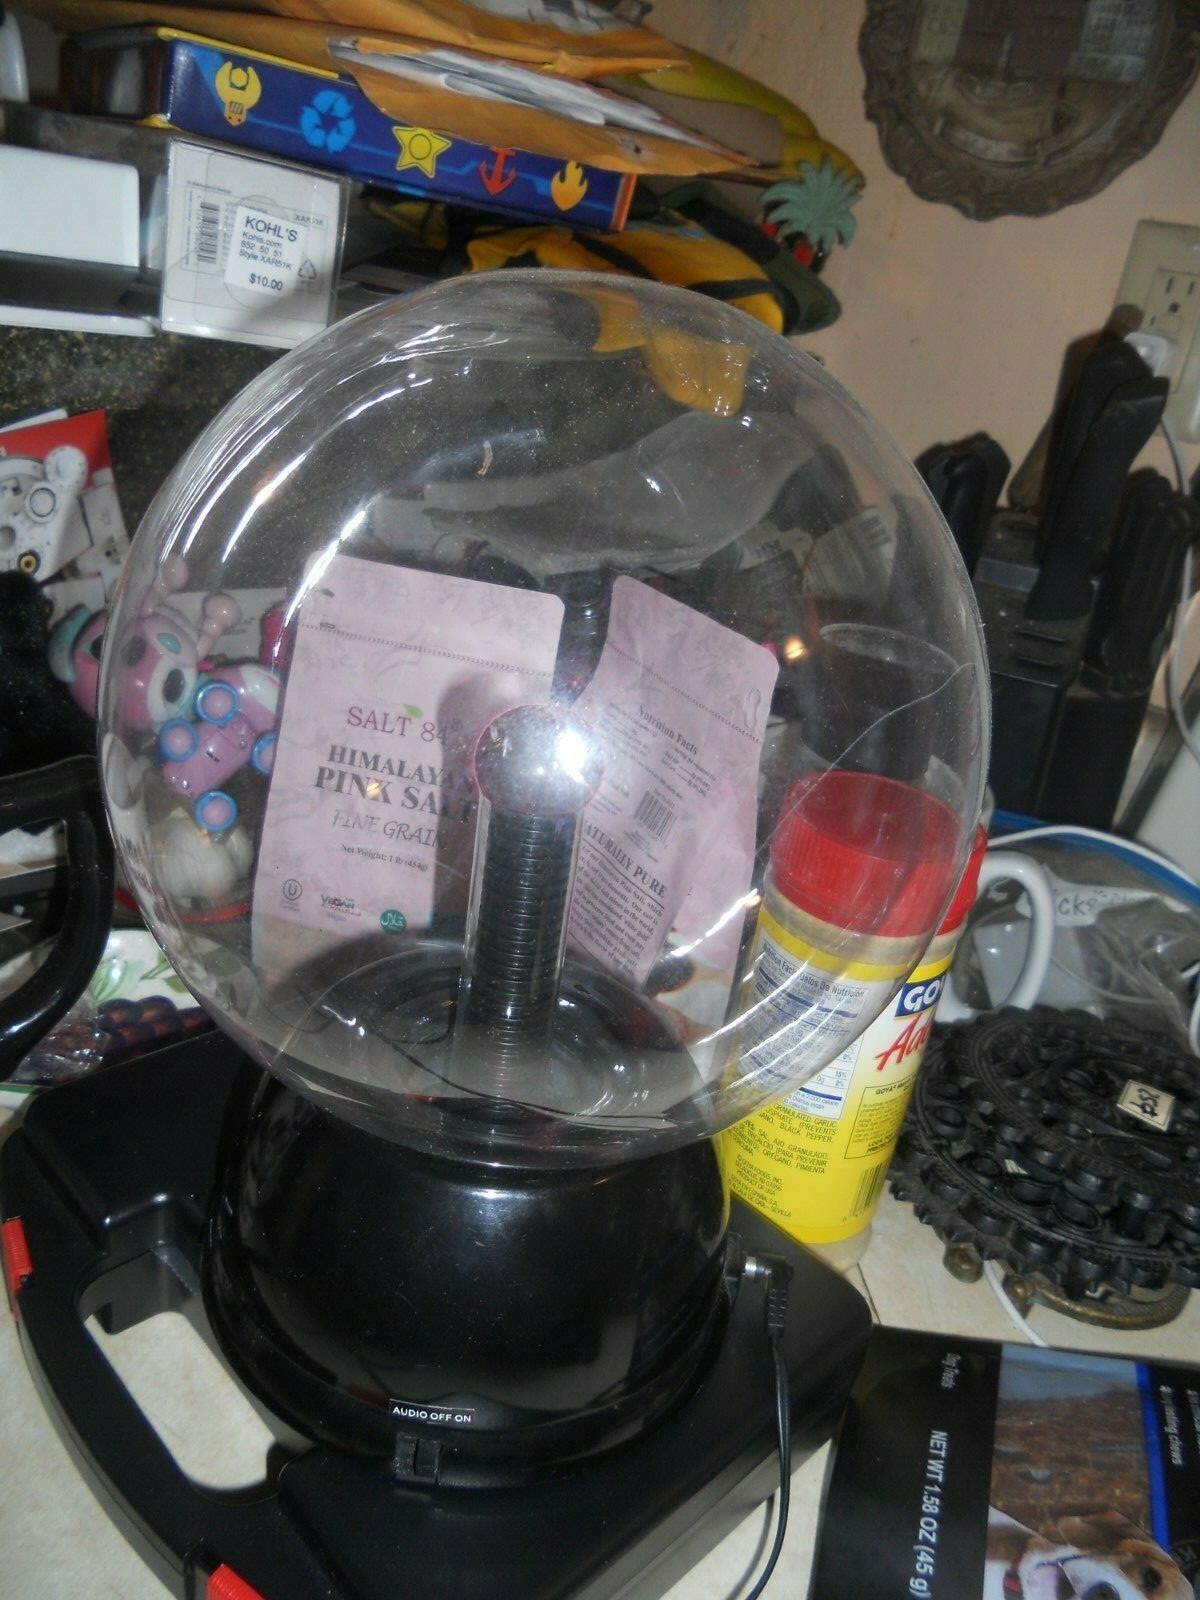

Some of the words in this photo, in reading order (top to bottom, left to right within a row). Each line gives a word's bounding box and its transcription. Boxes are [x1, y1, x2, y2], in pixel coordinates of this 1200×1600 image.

[242, 231, 282, 248] Kohls.com
[245, 216, 298, 242] KOHL'S
[249, 273, 283, 291] $10.00
[347, 706, 413, 737] SALT
[584, 823, 634, 872] ATURALLY
[633, 866, 668, 899] PURE
[904, 978, 943, 1012] GO
[392, 1406, 428, 1419] AUDIO
[430, 1412, 452, 1421] OFF
[455, 1414, 471, 1422] ON
[929, 1430, 948, 1458] NET
[926, 1460, 944, 1482] WT
[922, 1485, 941, 1514] 1.58
[918, 1517, 937, 1543] OZ
[913, 1545, 935, 1575] (45
[909, 1577, 931, 1598] g)
